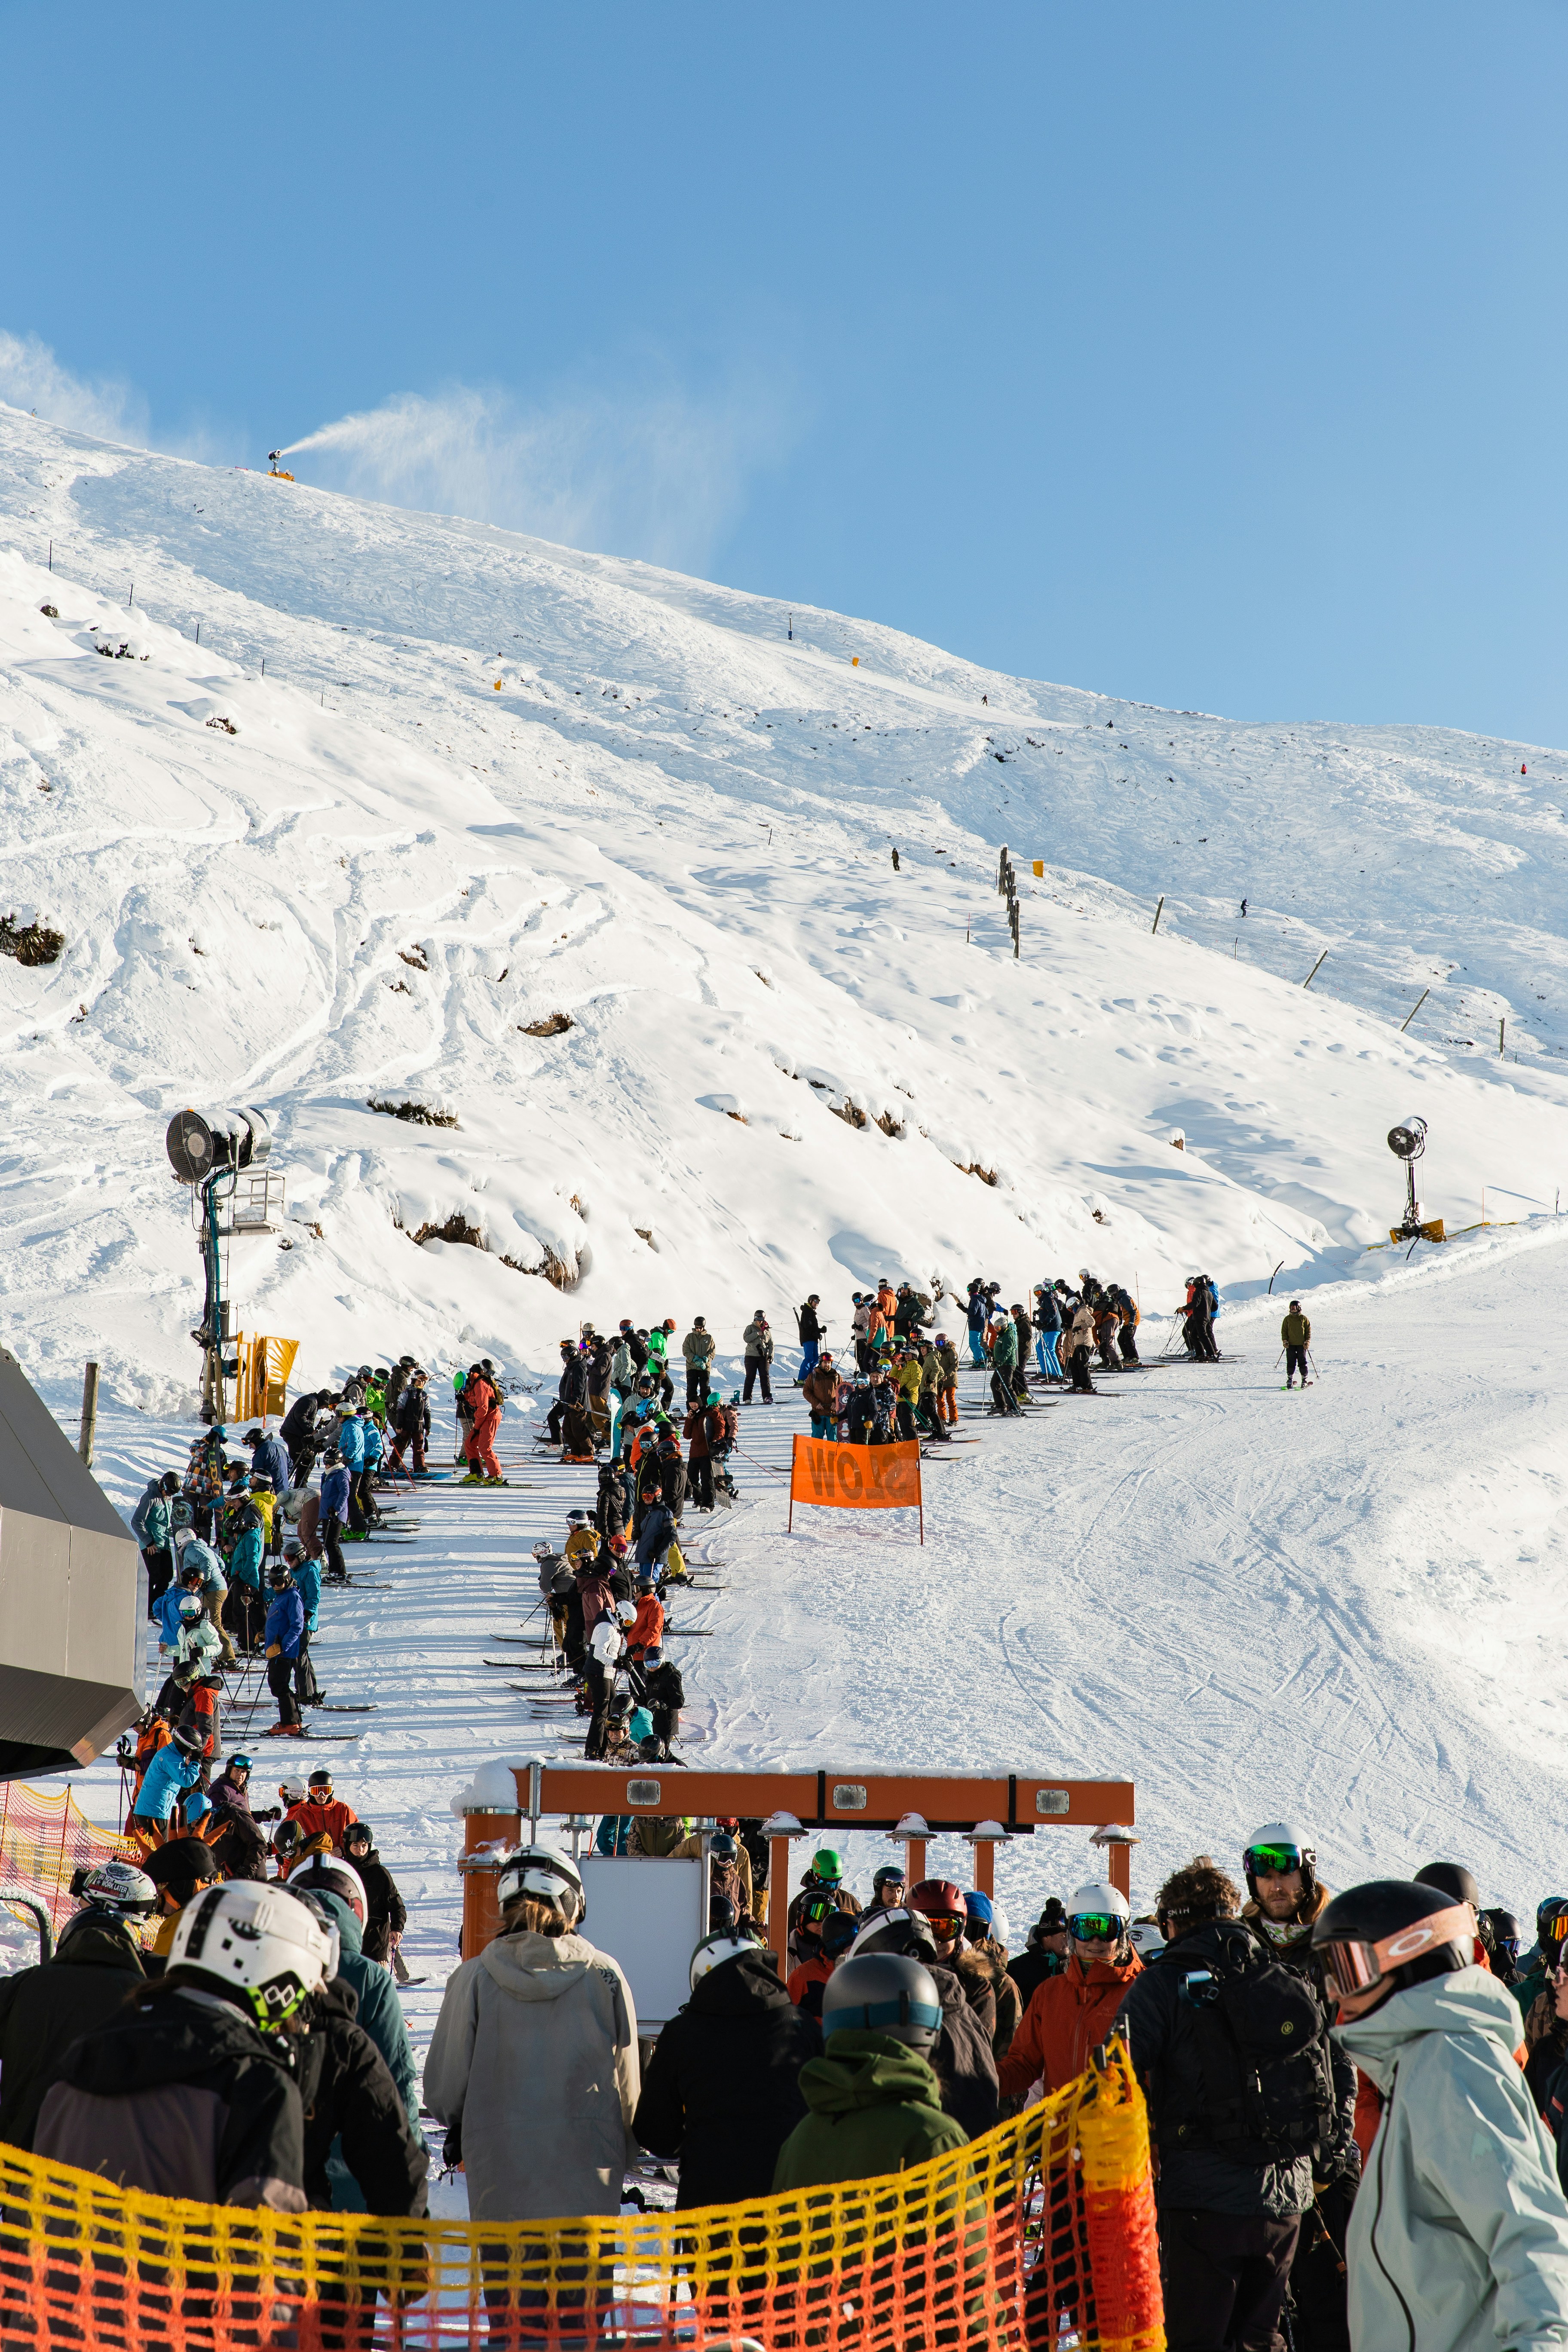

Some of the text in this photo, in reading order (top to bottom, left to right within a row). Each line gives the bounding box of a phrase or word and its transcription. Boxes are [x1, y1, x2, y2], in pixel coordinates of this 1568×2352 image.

[101, 1880, 128, 1894] WORK LATER
[1167, 1907, 1189, 1917] SMIH
